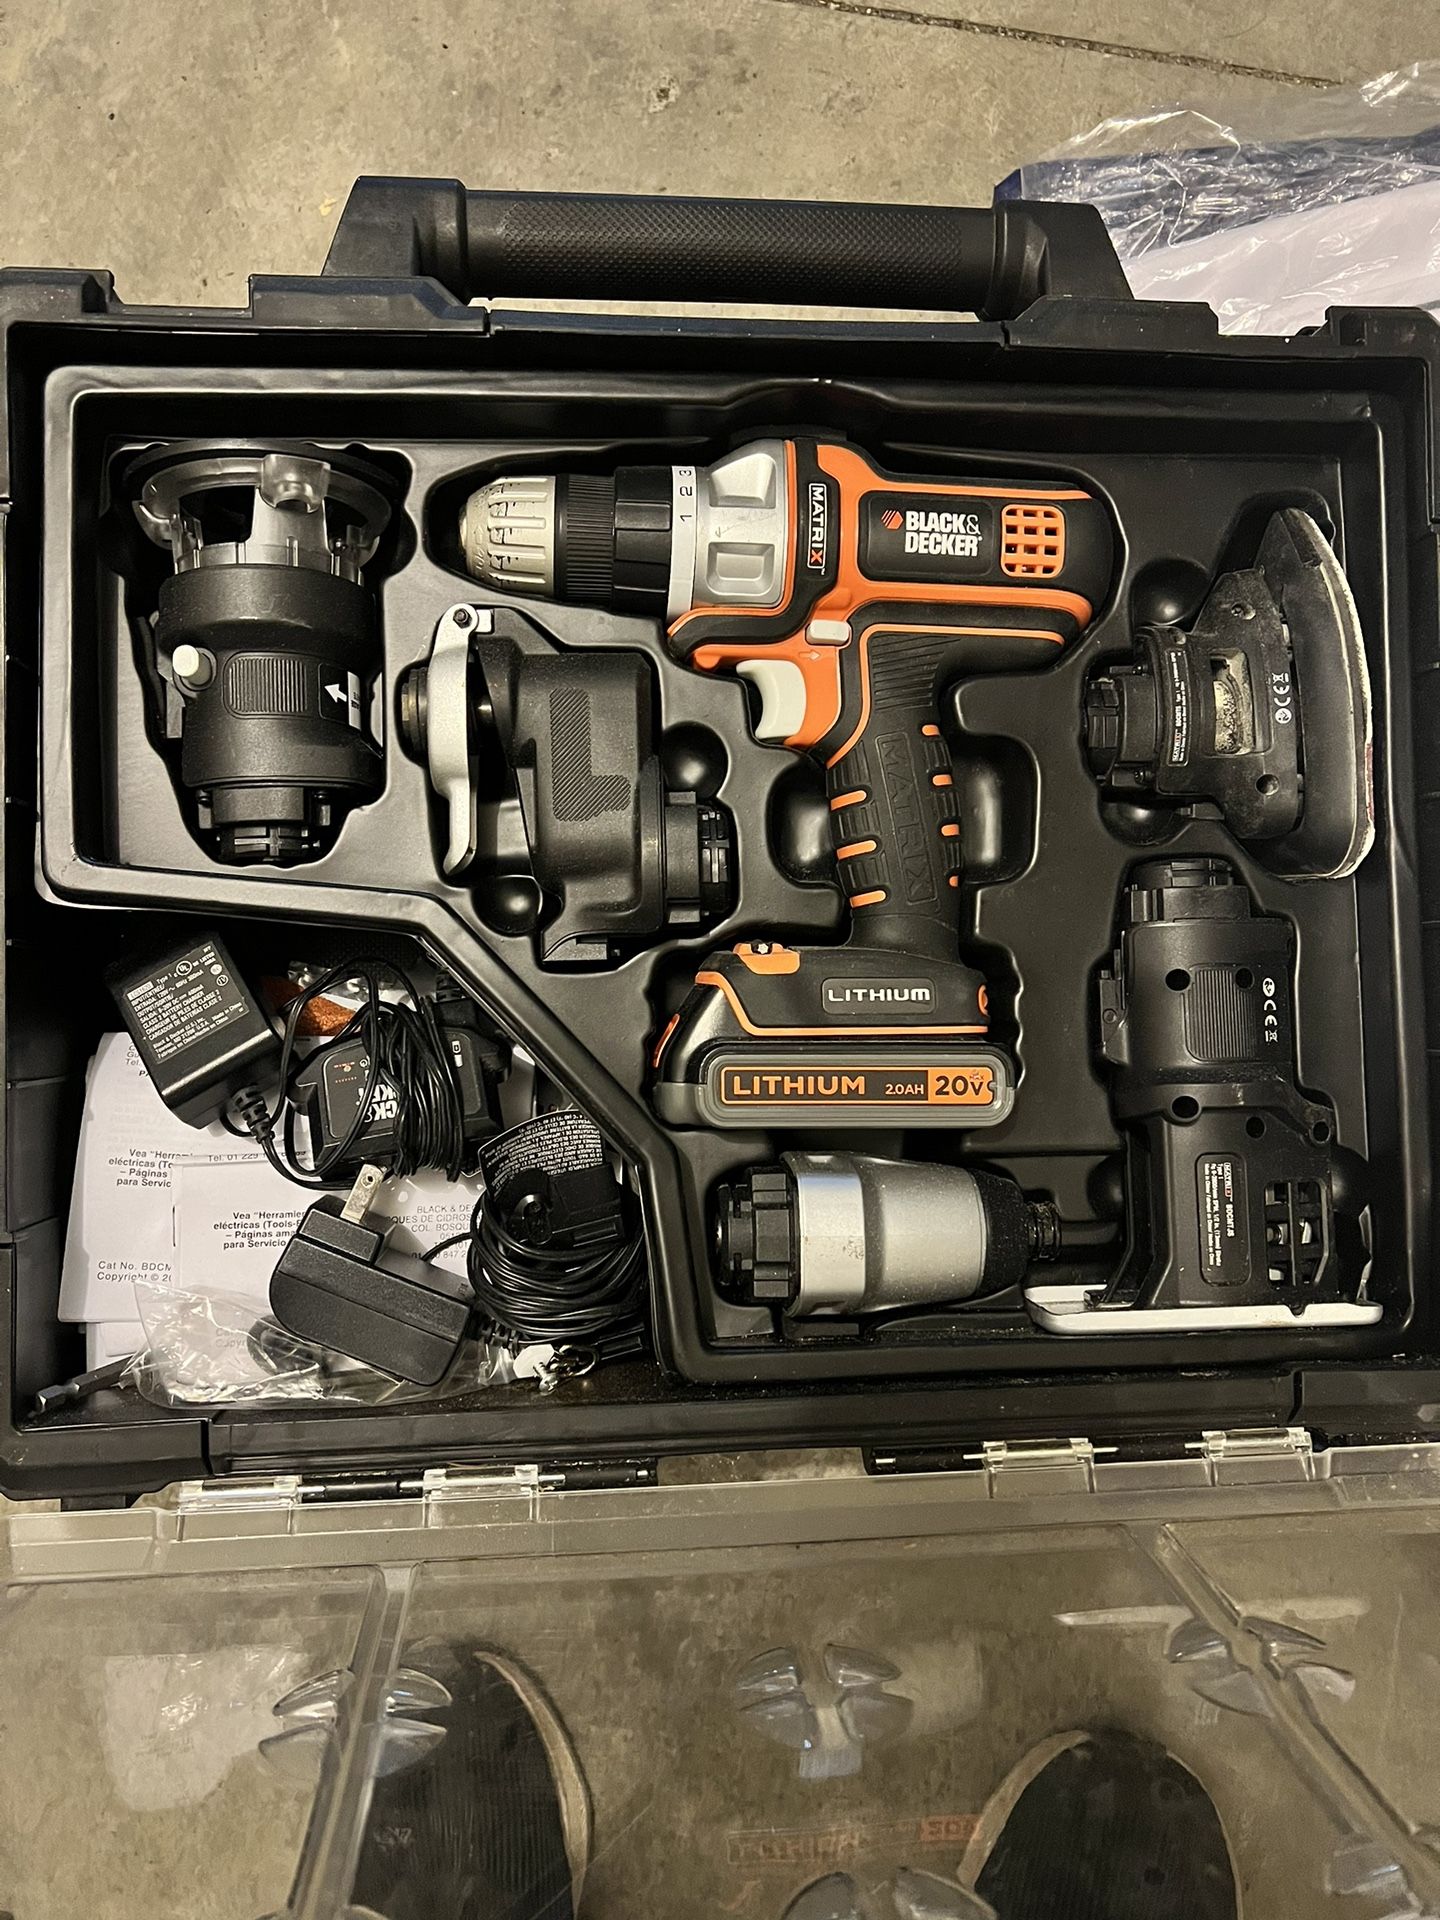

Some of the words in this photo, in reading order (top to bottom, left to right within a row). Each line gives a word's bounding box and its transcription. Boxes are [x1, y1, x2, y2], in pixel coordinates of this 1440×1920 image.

[680, 486, 693, 496] 2
[810, 486, 825, 564] MATRIX
[904, 532, 978, 556] DECKER
[828, 988, 930, 1002] LITHIUM
[161, 1003, 182, 1018] BATTERY
[733, 1075, 866, 1095] LITHIUM
[885, 1084, 924, 1095] 2.0AH
[129, 1148, 147, 1158] Vea
[108, 1158, 156, 1168] eléctricas
[128, 1168, 168, 1180] Páginas
[116, 1178, 138, 1188] para
[417, 1206, 448, 1214] BLACK
[232, 1212, 251, 1220] Vea
[213, 1222, 260, 1230] eléctricas
[234, 1230, 273, 1240] Páginas
[224, 1240, 244, 1250] para
[248, 1239, 287, 1248] Servicio
[98, 1260, 117, 1270] Cat
[120, 1262, 138, 1271] No.
[97, 1272, 148, 1282] Copyright
